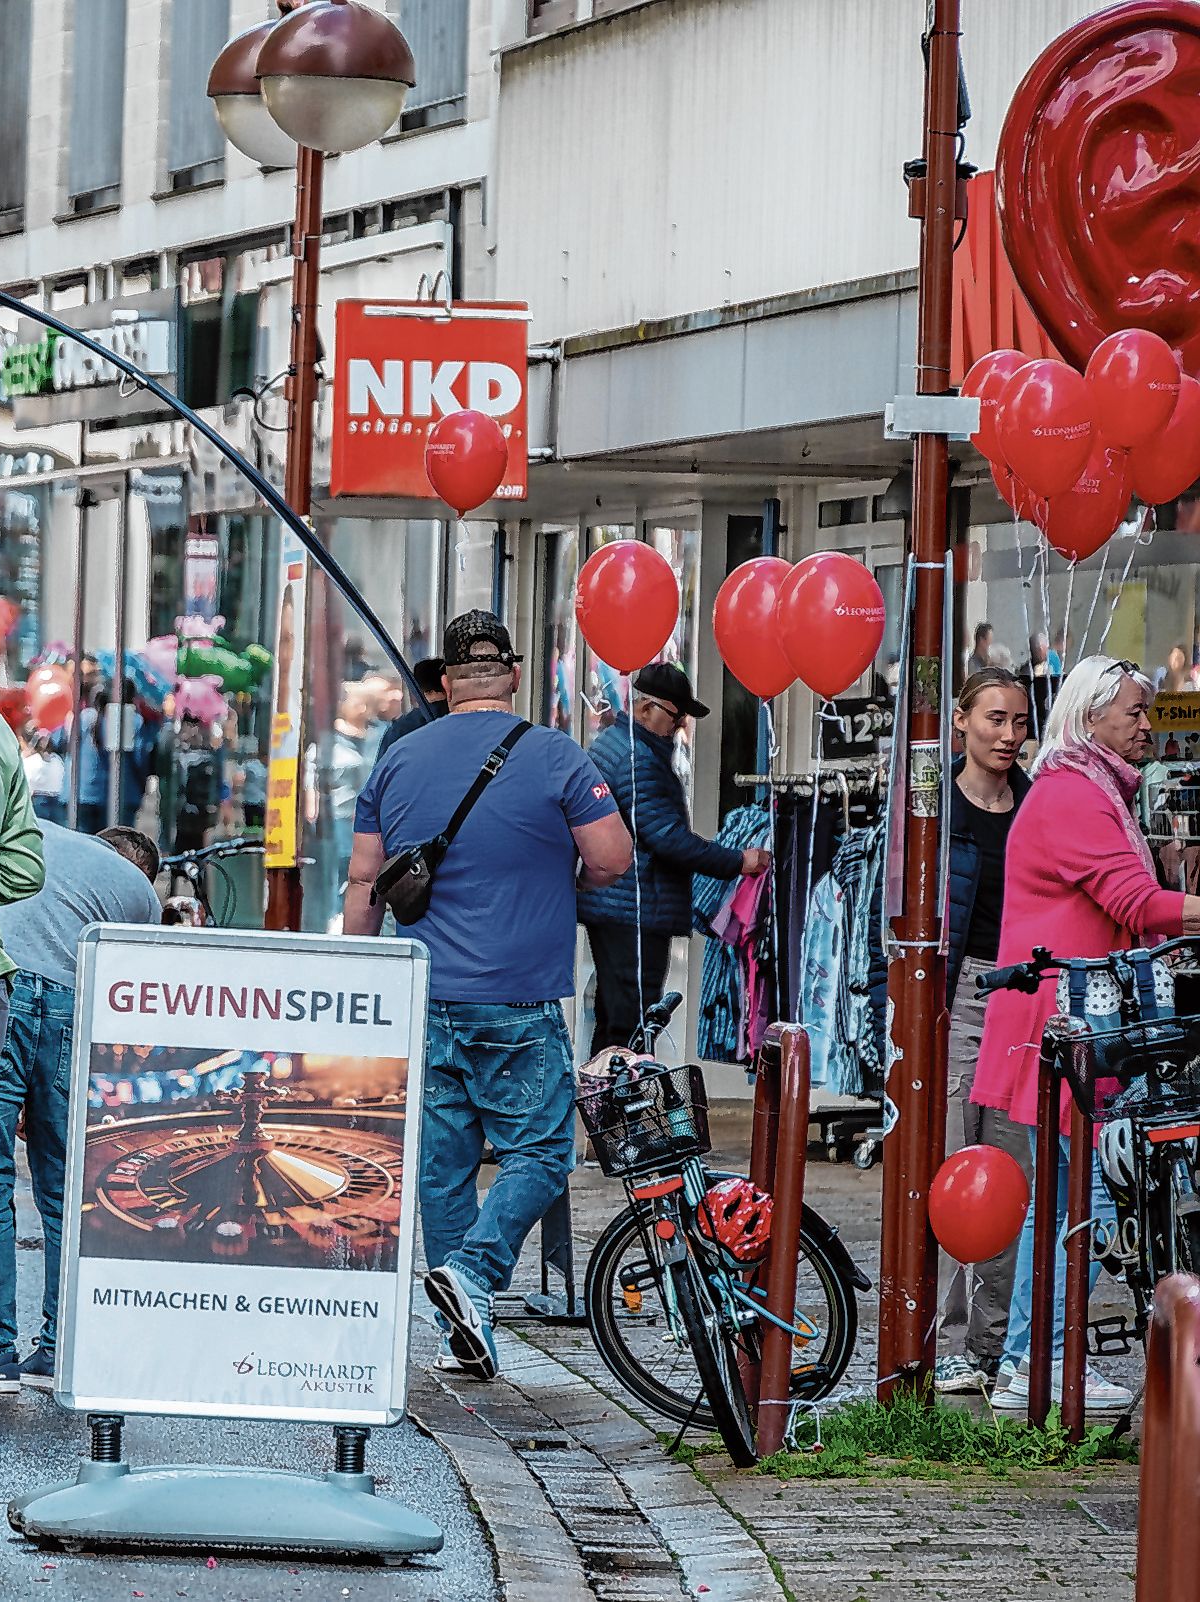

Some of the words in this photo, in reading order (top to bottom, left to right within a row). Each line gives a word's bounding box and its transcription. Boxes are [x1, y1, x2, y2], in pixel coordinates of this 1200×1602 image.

[348, 359, 522, 417] NKD
[108, 981, 392, 1026] GEWINNSPIEL
[92, 1287, 227, 1312] MITMACHEN
[235, 1294, 251, 1313] &
[257, 1295, 379, 1319] GEWINNEN
[257, 1358, 377, 1381] LEONHARDT
[299, 1379, 375, 1394] AKUSTIK
